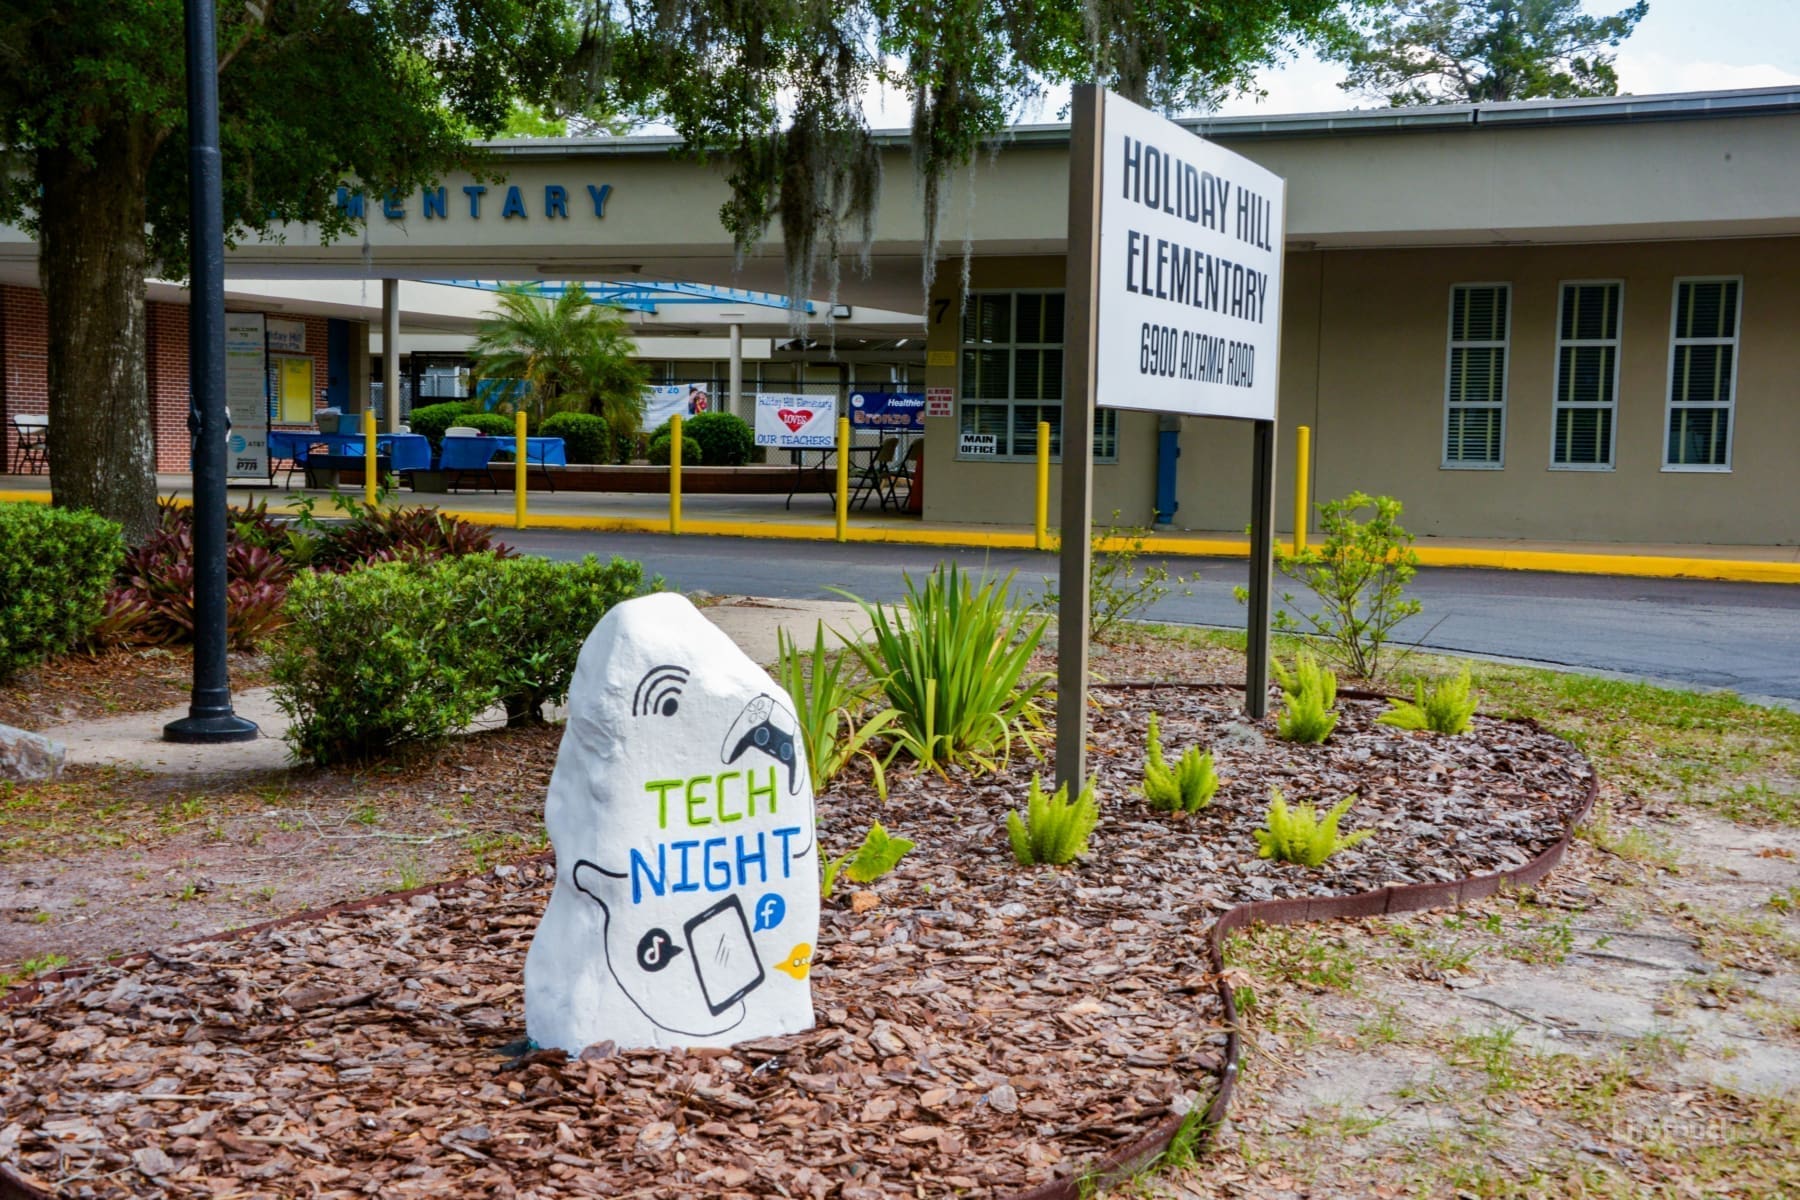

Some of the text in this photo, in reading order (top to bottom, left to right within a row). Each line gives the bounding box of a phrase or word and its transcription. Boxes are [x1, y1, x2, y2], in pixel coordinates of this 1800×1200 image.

[1122, 135, 1272, 253] HOLIDAY HILL
[1126, 229, 1268, 325] ELEMENTARY
[934, 298, 951, 324] 7
[1140, 322, 1255, 388] 6900 ALTAMA ROAD
[887, 398, 925, 407] Healthier
[783, 414, 807, 425] LOVES
[854, 410, 911, 425] Bronze
[757, 434, 832, 446] OUR TEACHERS
[963, 434, 993, 443] MAIN
[961, 445, 995, 454] OFFICE
[236, 462, 258, 471] PTA
[644, 766, 777, 829] TECH
[630, 826, 801, 904] NIGHT
